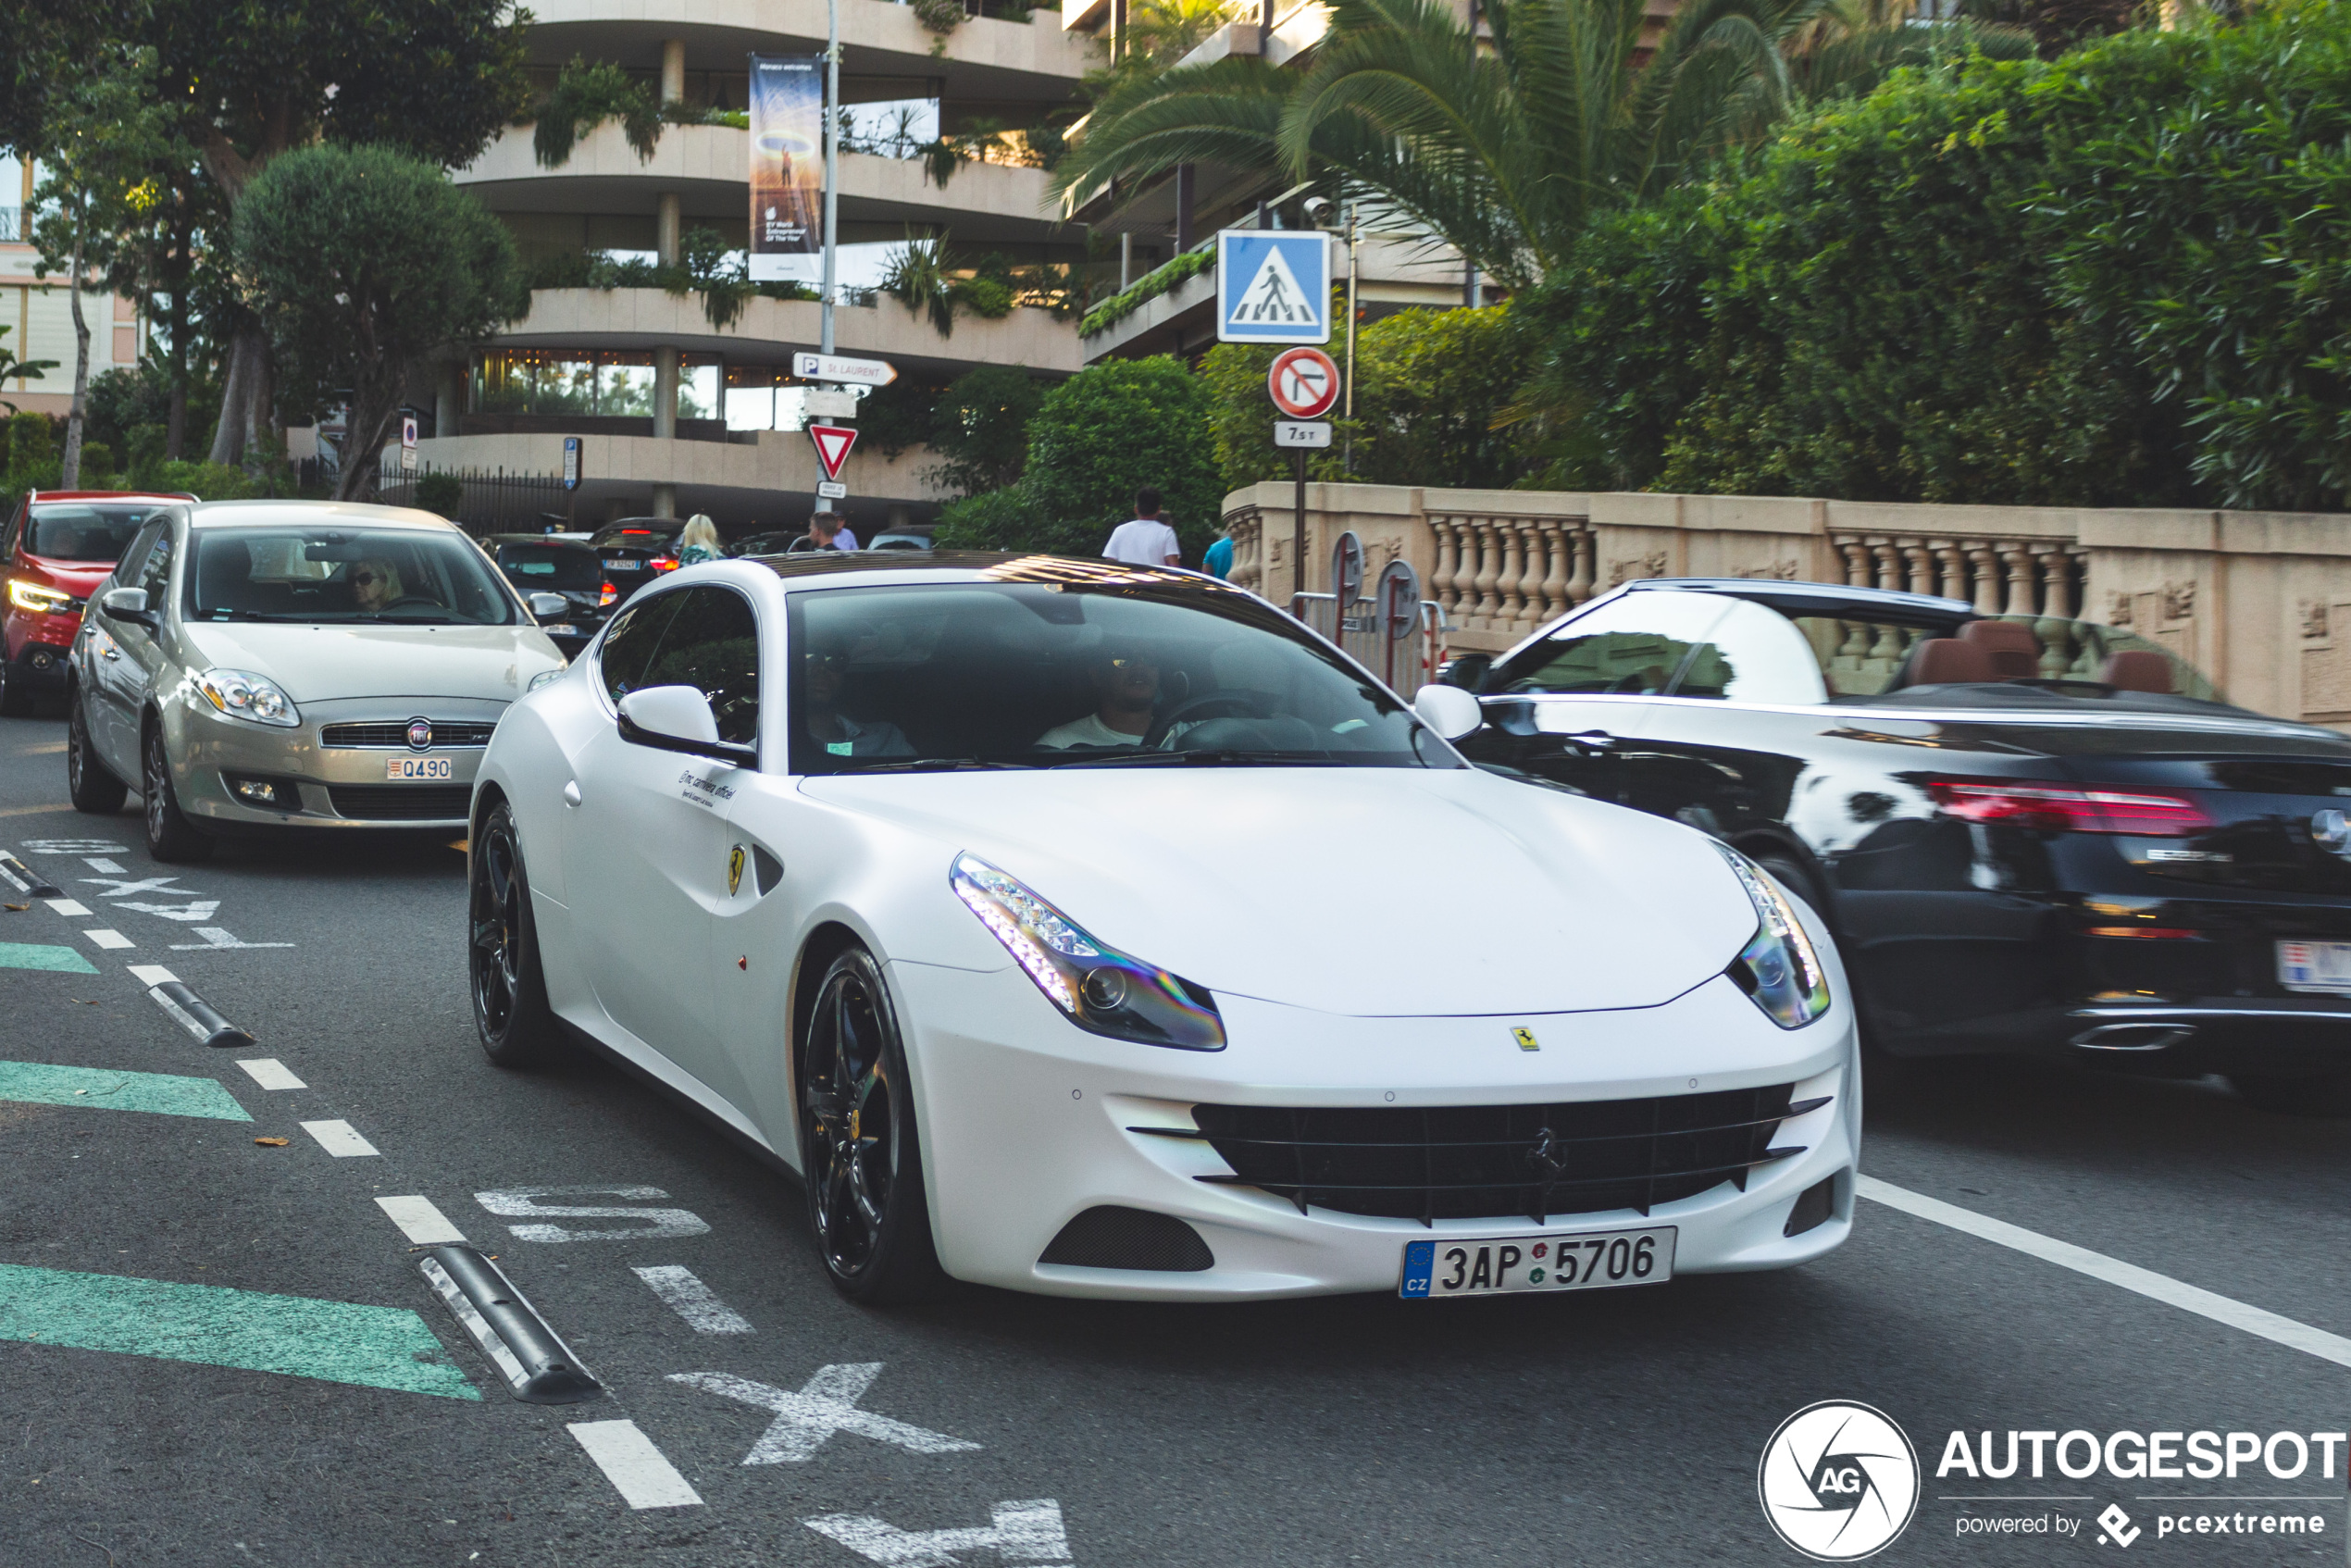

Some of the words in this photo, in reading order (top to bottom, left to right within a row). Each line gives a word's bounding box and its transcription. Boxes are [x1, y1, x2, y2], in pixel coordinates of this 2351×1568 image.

[840, 366, 880, 378] LAURENT
[413, 729, 427, 741] FIAT
[1441, 1245, 1521, 1290] 3AP
[1555, 1235, 1655, 1284] 5706
[1406, 1278, 1427, 1291] CZ
